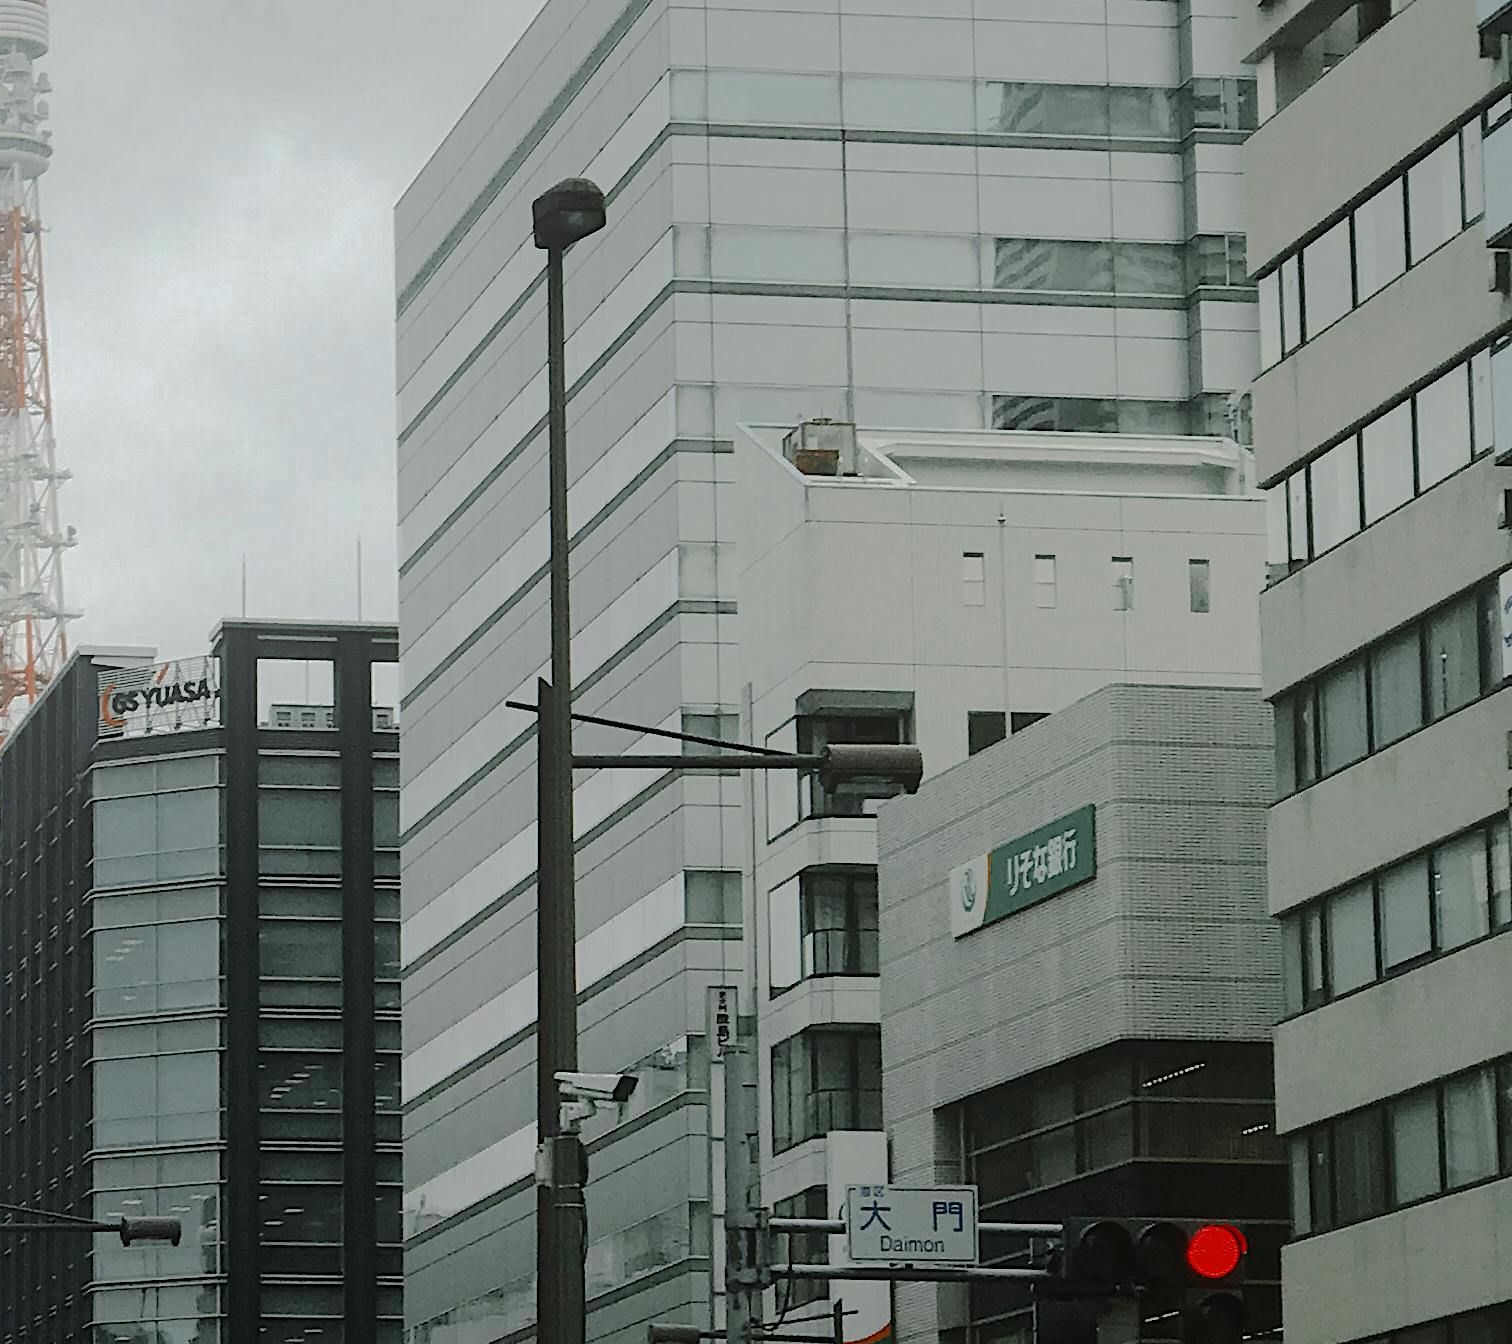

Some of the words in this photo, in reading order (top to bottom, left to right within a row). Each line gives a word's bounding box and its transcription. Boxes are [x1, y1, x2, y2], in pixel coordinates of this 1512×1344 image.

[140, 677, 211, 709] YUASA
[1007, 828, 1077, 897] りそな銀行
[880, 1236, 945, 1253] Daimon
